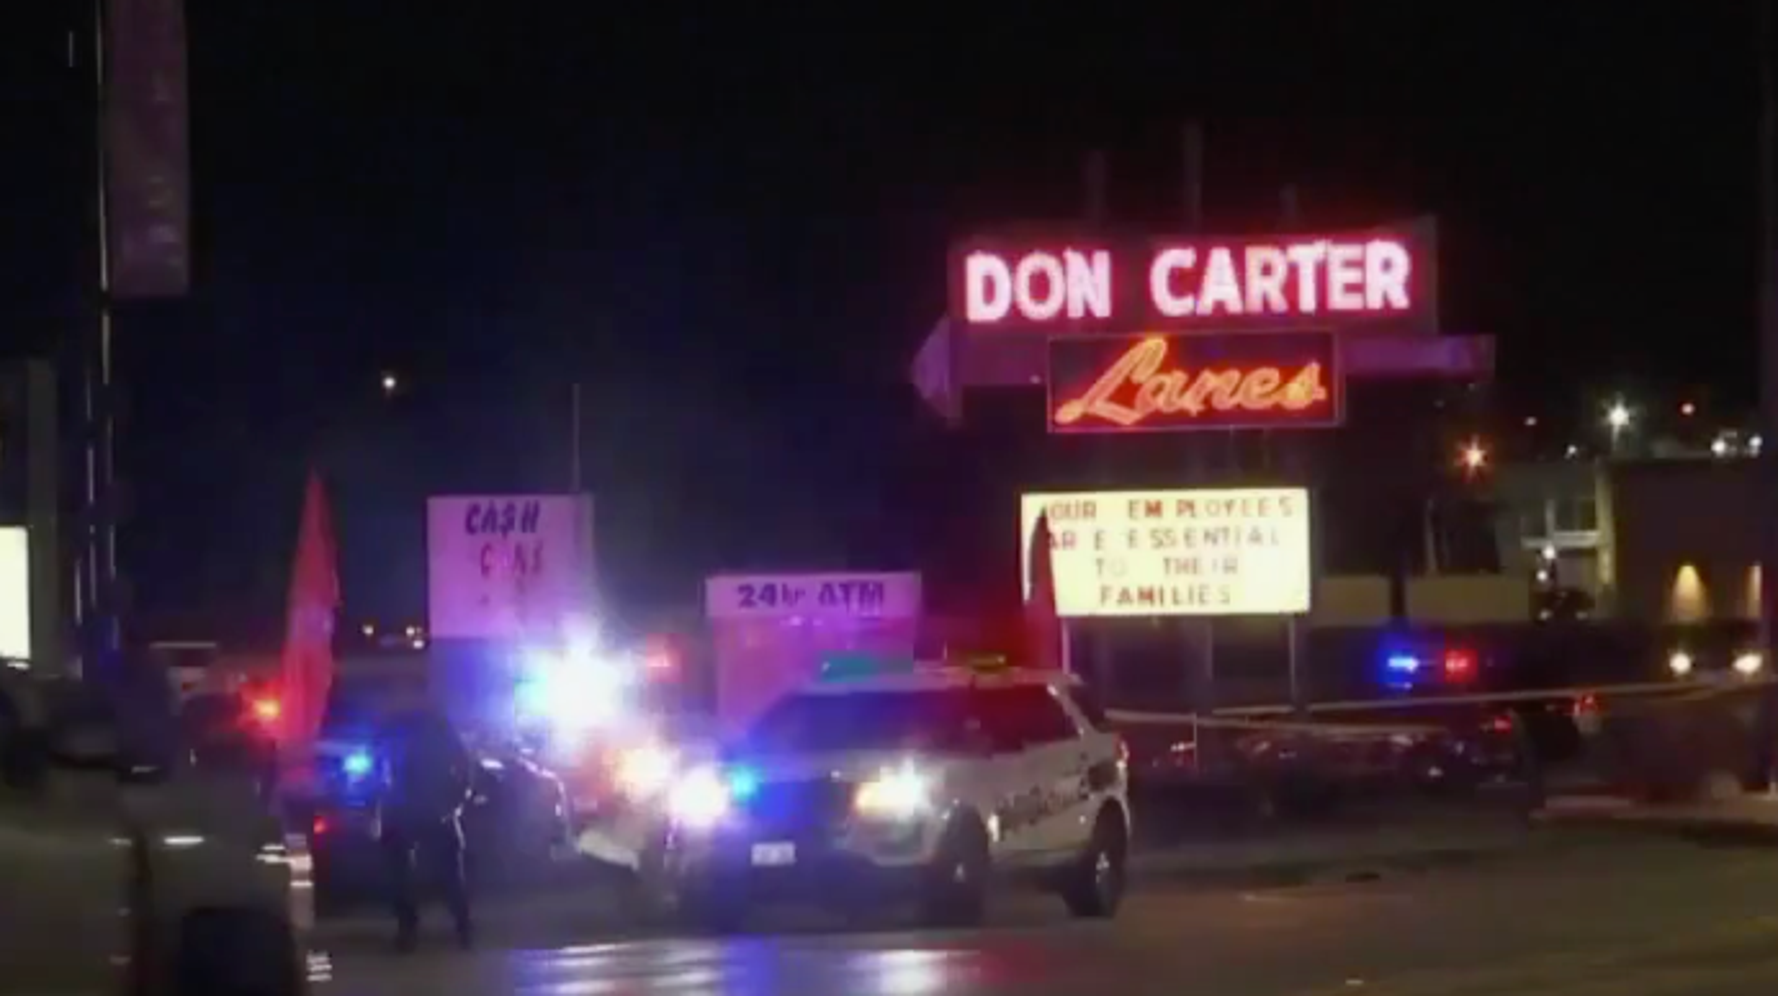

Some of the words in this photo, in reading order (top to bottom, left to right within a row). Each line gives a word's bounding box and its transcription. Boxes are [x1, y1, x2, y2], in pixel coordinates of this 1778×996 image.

[965, 249, 1111, 323] DON
[1150, 239, 1411, 317] CARTER
[1054, 334, 1327, 426] Lanes
[1095, 557, 1127, 577] TO
[1163, 556, 1238, 576] THEIR
[818, 581, 884, 611] ATM
[1100, 584, 1231, 606] FAMILIES
